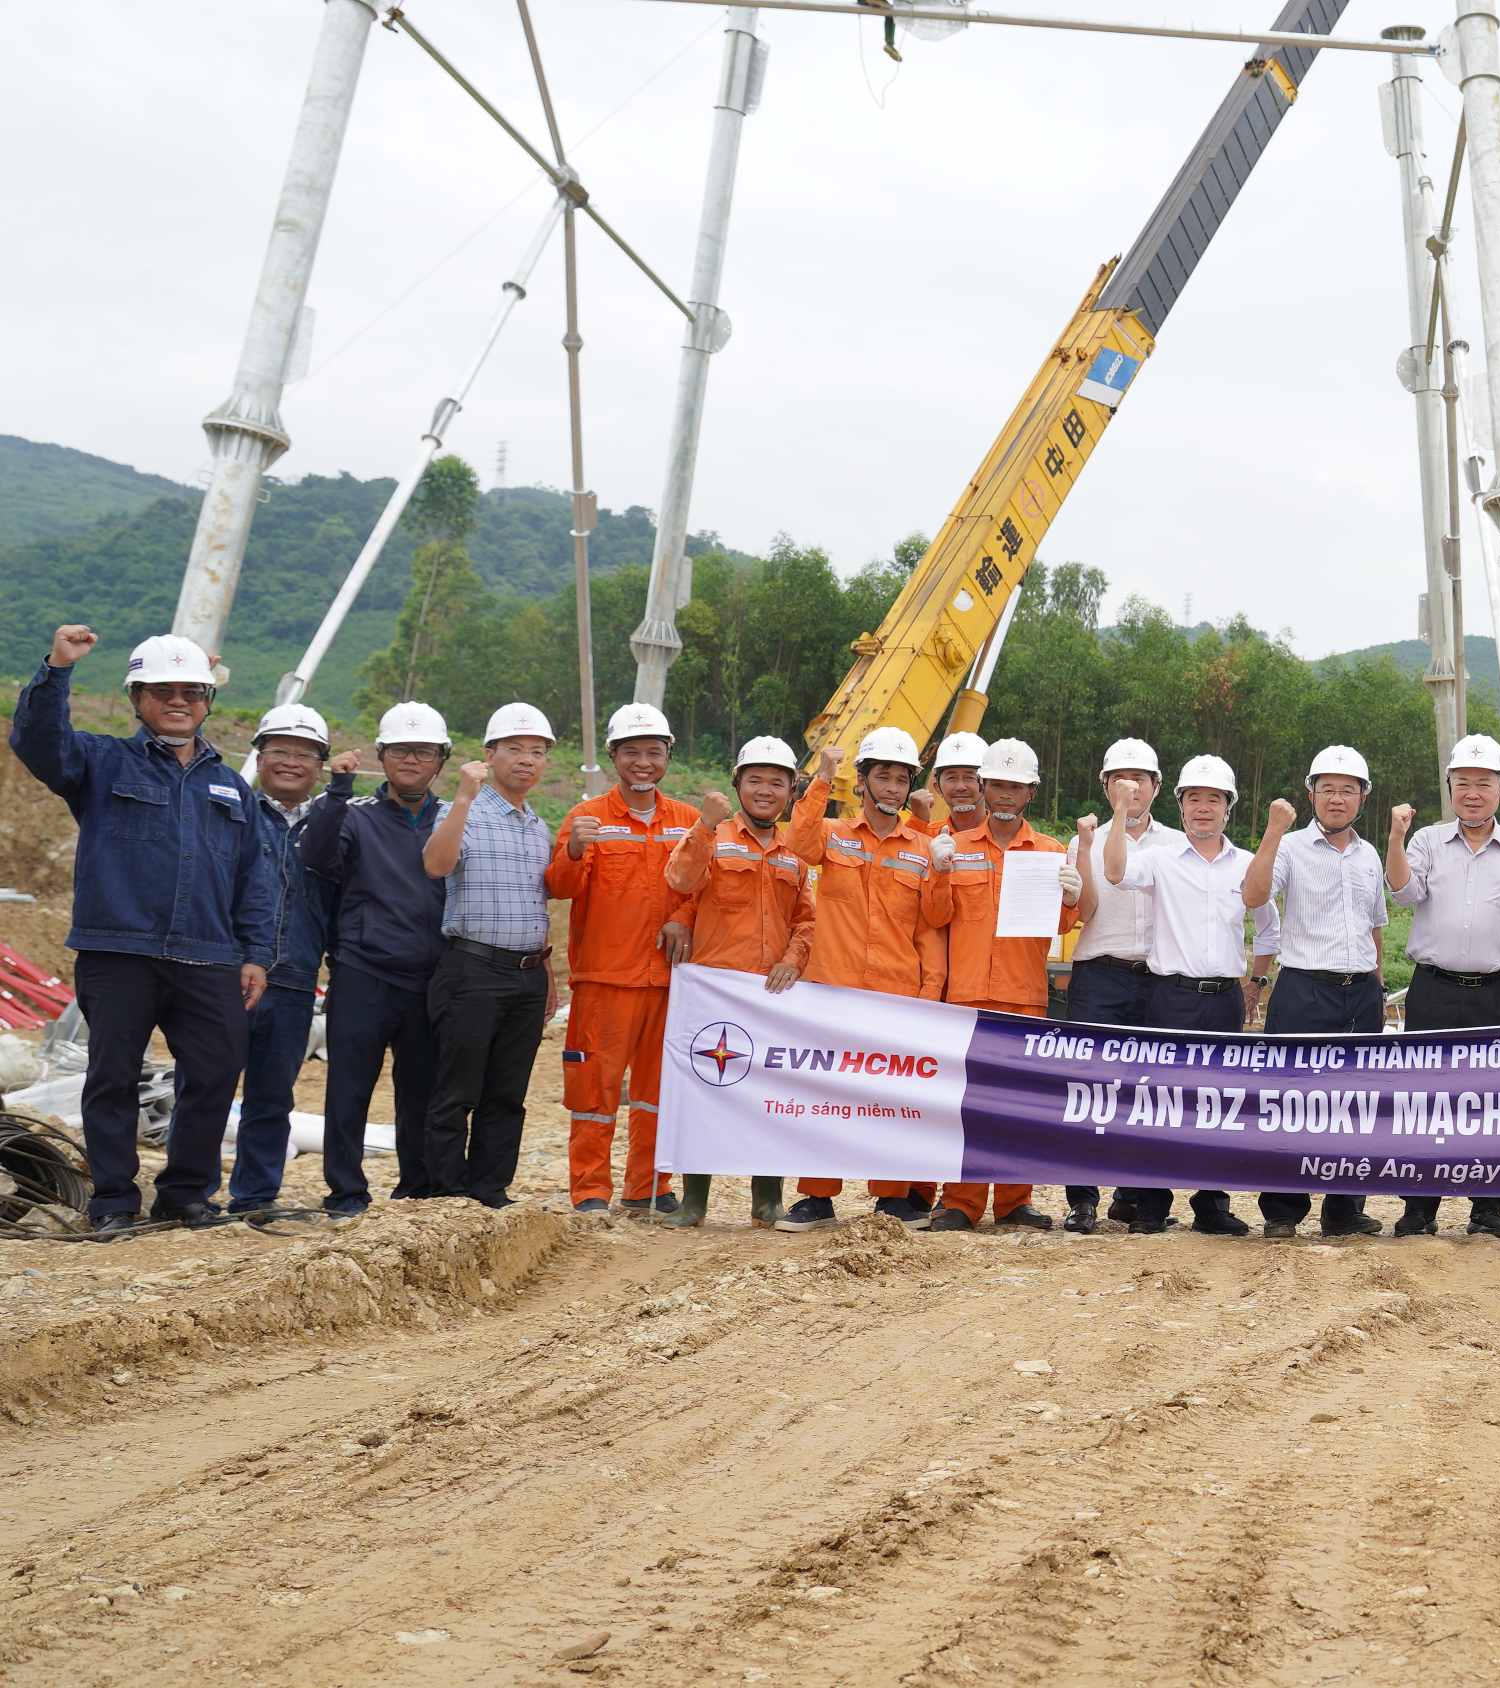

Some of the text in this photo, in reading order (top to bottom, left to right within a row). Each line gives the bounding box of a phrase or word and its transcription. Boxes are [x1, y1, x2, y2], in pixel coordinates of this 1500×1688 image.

[1023, 1027, 1095, 1061] TỔNG
[1101, 1036, 1177, 1065] CÔNG
[1185, 1043, 1217, 1067] TY
[1222, 1040, 1288, 1073] ĐIỆN
[1294, 1042, 1346, 1074] LỰC
[1354, 1041, 1443, 1071] THÀNH
[763, 1097, 922, 1119] Thắp sáng niềm tin
[1062, 1078, 1122, 1135] DỰ
[1126, 1075, 1184, 1128] ÁN
[1195, 1086, 1247, 1131] ĐZ
[1257, 1088, 1381, 1135] 500KV
[1300, 1156, 1372, 1181] Nghệ
[1378, 1158, 1423, 1182] An,
